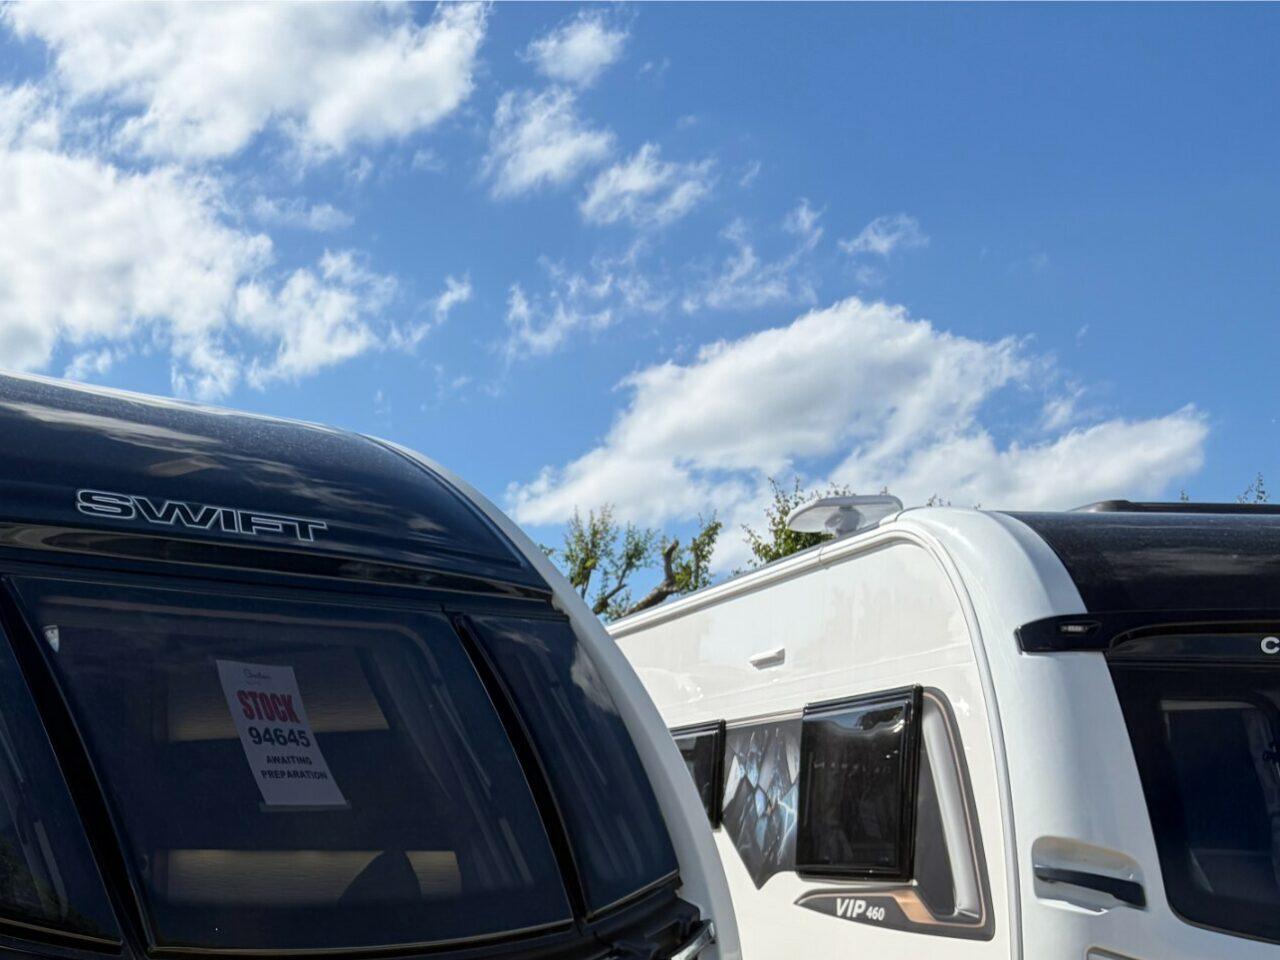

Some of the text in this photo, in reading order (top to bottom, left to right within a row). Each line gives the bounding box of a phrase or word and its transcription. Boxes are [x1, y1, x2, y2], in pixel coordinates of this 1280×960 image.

[77, 488, 328, 542] SWIFT
[236, 689, 300, 724] STOCK
[248, 726, 310, 747] 94645
[267, 755, 312, 766] AWAITING
[261, 769, 328, 780] PREPARATION
[836, 898, 885, 921] VIP 460
